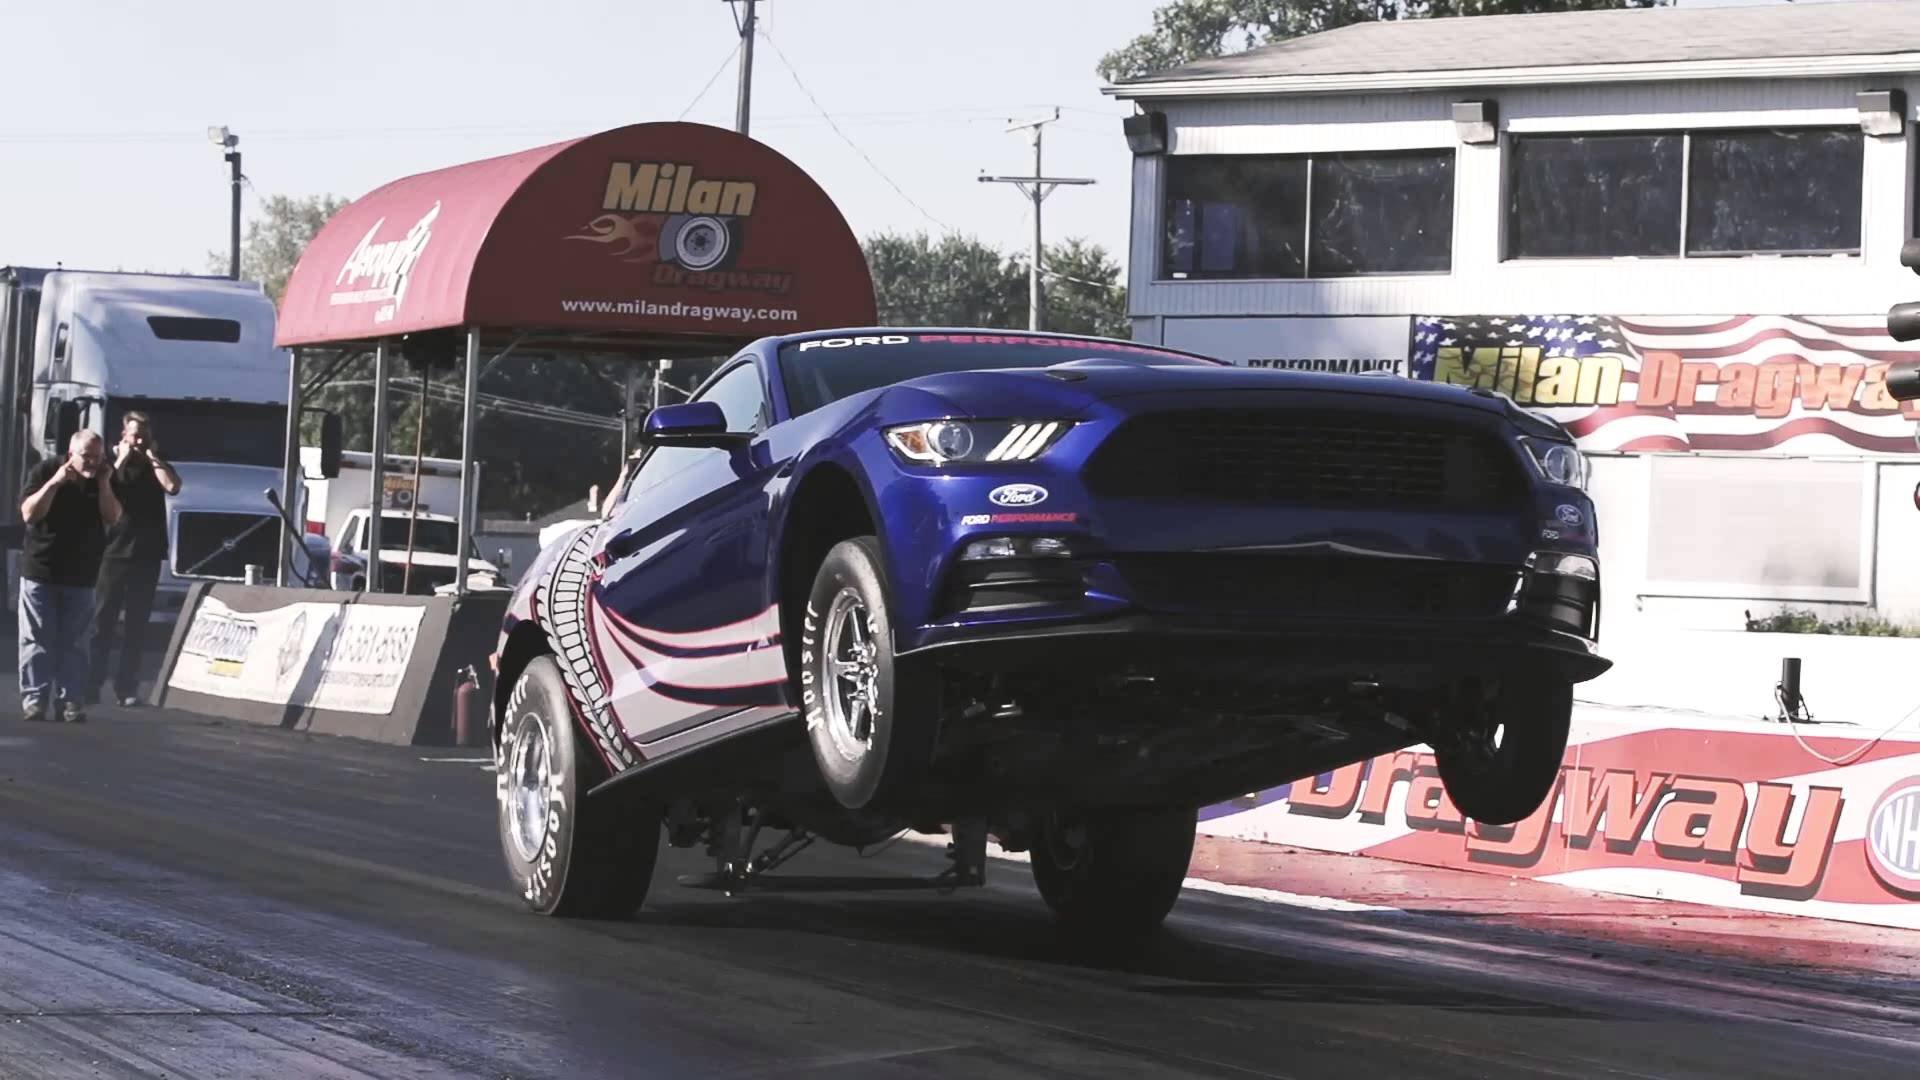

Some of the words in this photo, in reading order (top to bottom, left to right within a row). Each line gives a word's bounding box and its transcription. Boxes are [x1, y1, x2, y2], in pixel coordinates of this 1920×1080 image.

[603, 161, 756, 216] Milan
[562, 299, 798, 322] www.milandragway.com
[800, 335, 910, 351] FORD
[1433, 345, 1624, 408] Milan
[1636, 350, 1920, 421] Dragwa
[999, 485, 1039, 503] Ford
[961, 513, 991, 526] FORD
